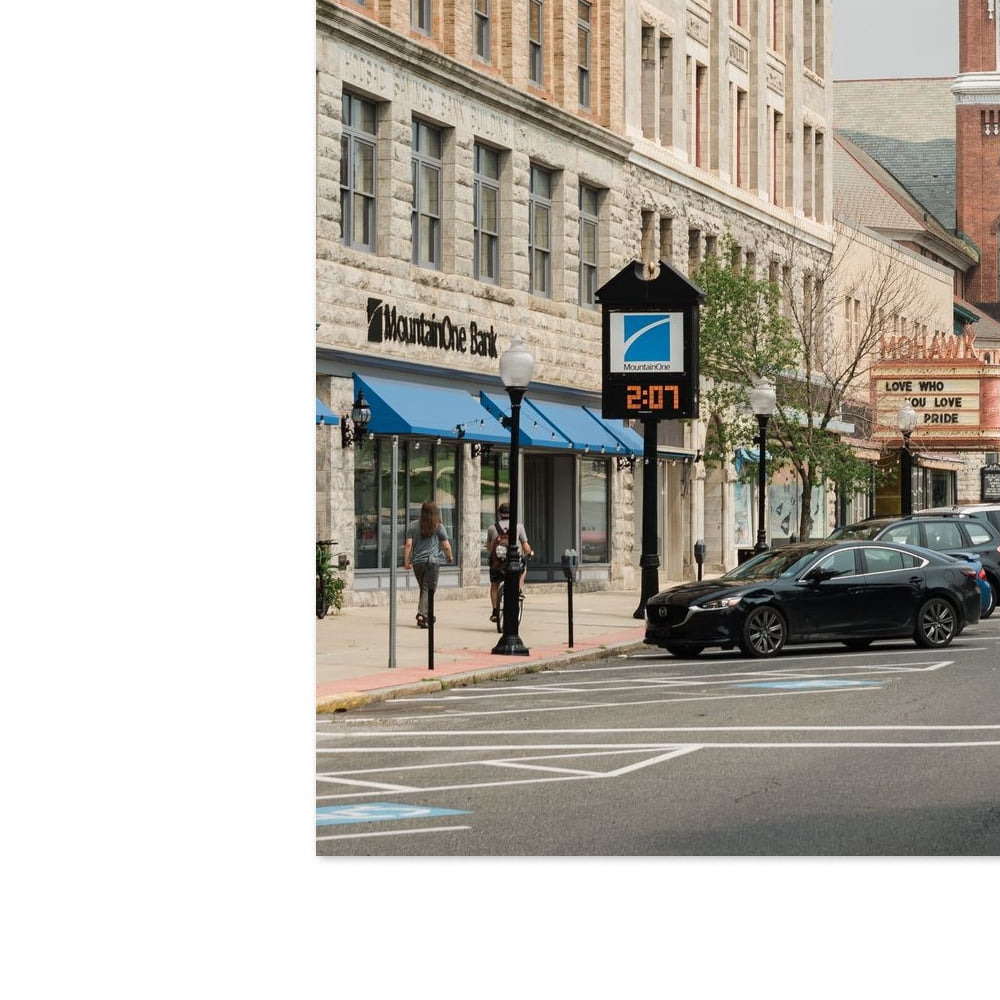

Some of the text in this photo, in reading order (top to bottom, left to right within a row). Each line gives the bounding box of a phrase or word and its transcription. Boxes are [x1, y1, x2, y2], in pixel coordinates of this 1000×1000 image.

[384, 304, 498, 358] MountainOne Bank
[880, 335, 978, 359] MOHAWK
[623, 363, 671, 371] MountainOne
[886, 381, 944, 391] LOVE WHO
[626, 385, 679, 410] 2:07
[934, 397, 962, 407] LOVE
[924, 413, 959, 423] PRIDE
